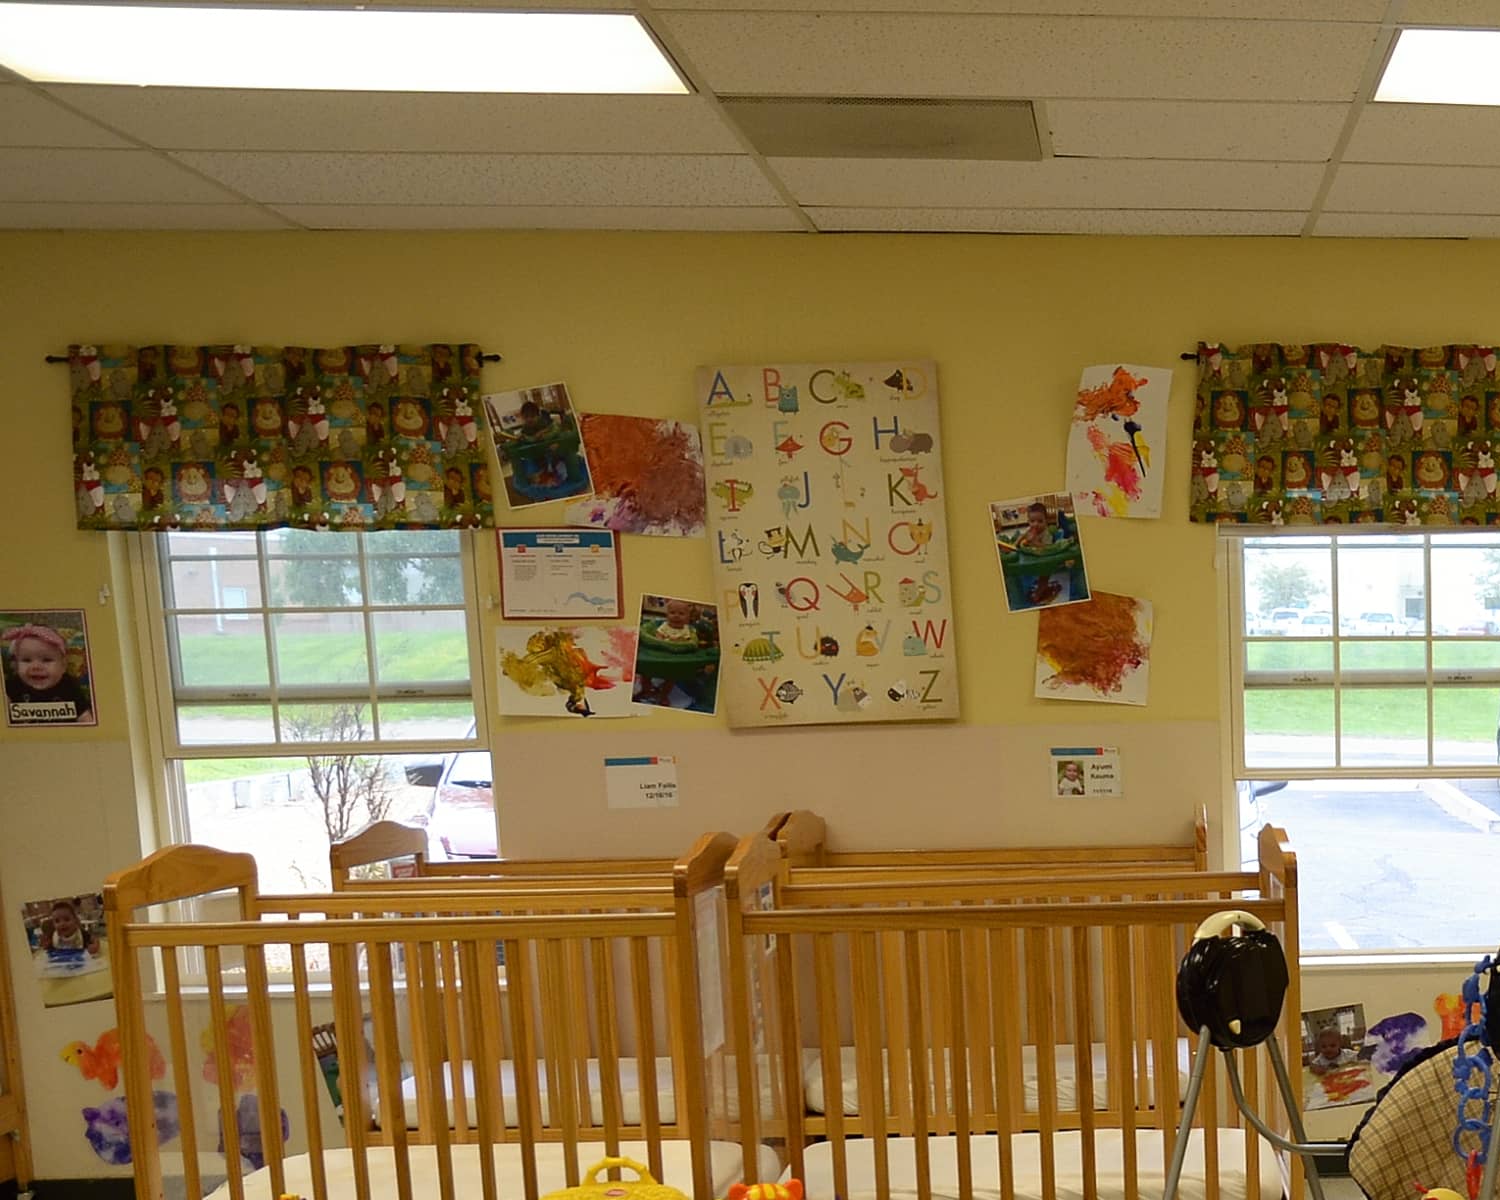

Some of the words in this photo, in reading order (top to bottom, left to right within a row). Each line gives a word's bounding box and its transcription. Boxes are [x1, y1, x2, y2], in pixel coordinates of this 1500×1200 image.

[707, 370, 735, 405] A
[763, 368, 781, 403] B
[809, 369, 838, 404] C
[902, 367, 928, 401] D
[709, 422, 727, 457] E
[819, 421, 854, 457] G
[872, 415, 900, 450] H
[727, 479, 740, 512] I
[797, 472, 809, 509] J
[888, 473, 914, 507] K
[718, 530, 733, 564] L
[783, 523, 820, 559] M
[841, 517, 871, 551] N
[724, 589, 740, 623] P
[785, 576, 821, 613] Q
[864, 571, 886, 605] R
[923, 571, 942, 605] S
[762, 631, 781, 664] T
[796, 625, 821, 660] U
[912, 619, 947, 649] W
[12, 703, 75, 718] Savannah
[757, 676, 781, 712] X
[822, 673, 846, 707] Y
[919, 670, 942, 704] Z
